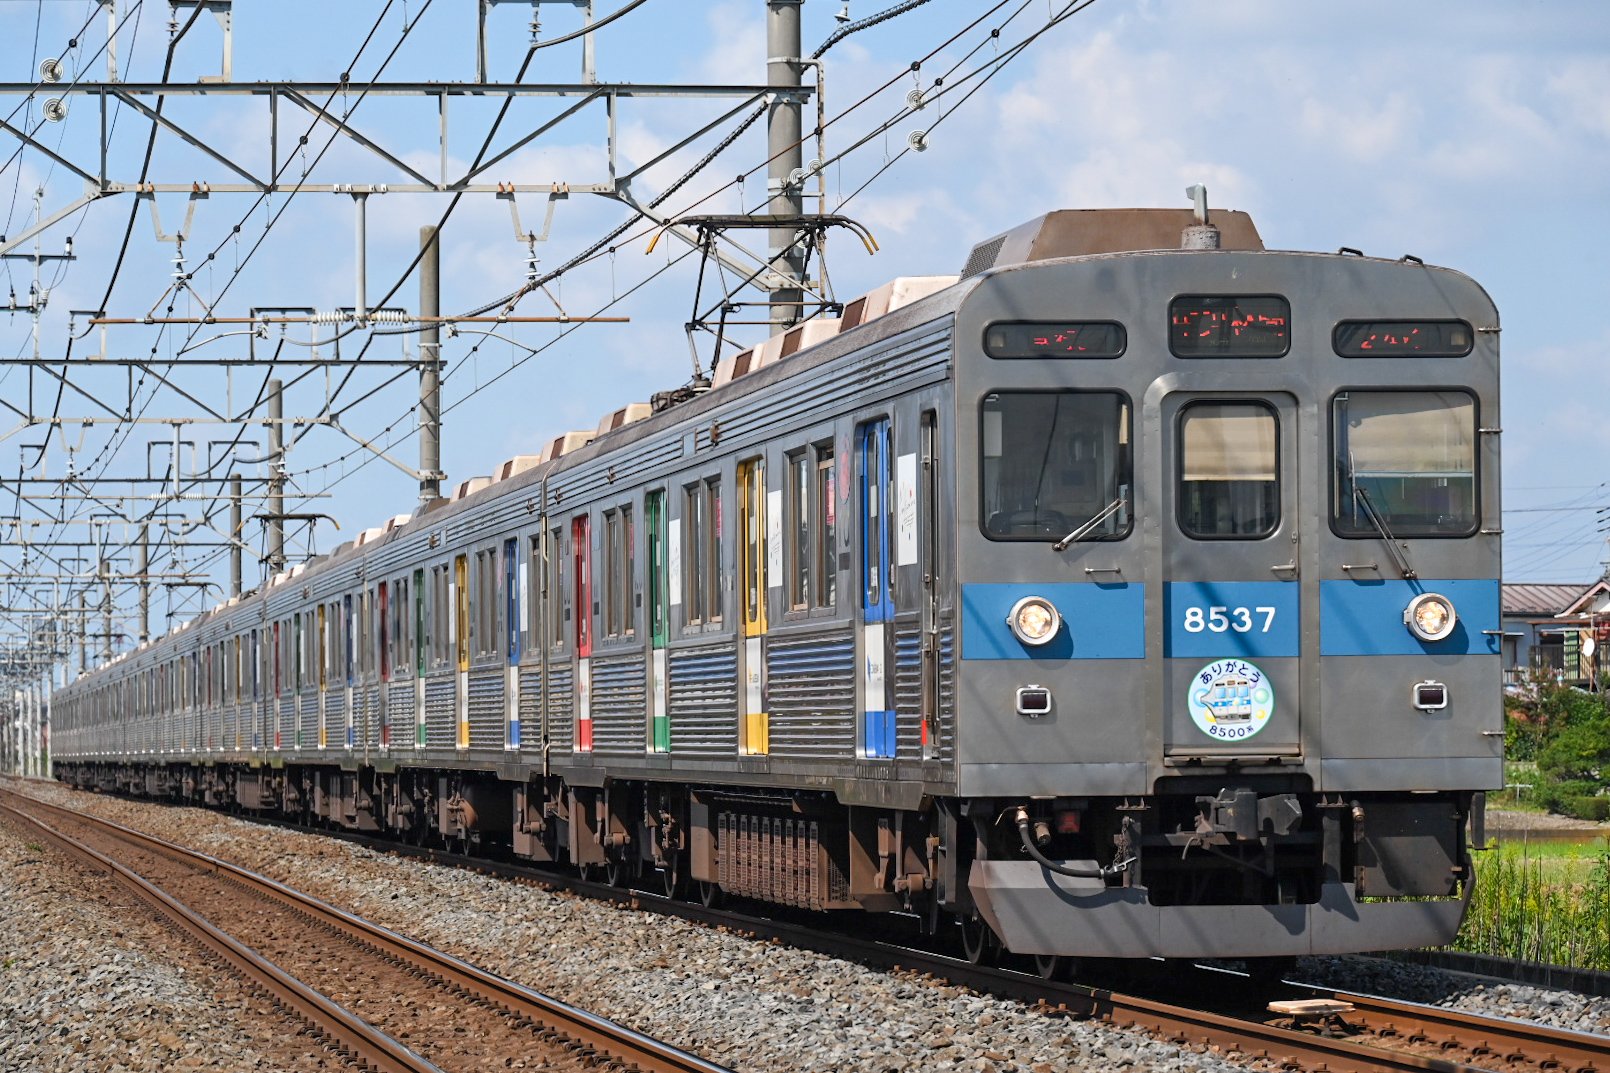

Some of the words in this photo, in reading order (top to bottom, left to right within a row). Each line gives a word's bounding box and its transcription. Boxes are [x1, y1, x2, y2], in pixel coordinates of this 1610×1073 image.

[1184, 607, 1275, 633] 8537
[1201, 661, 1261, 684] ありがとう
